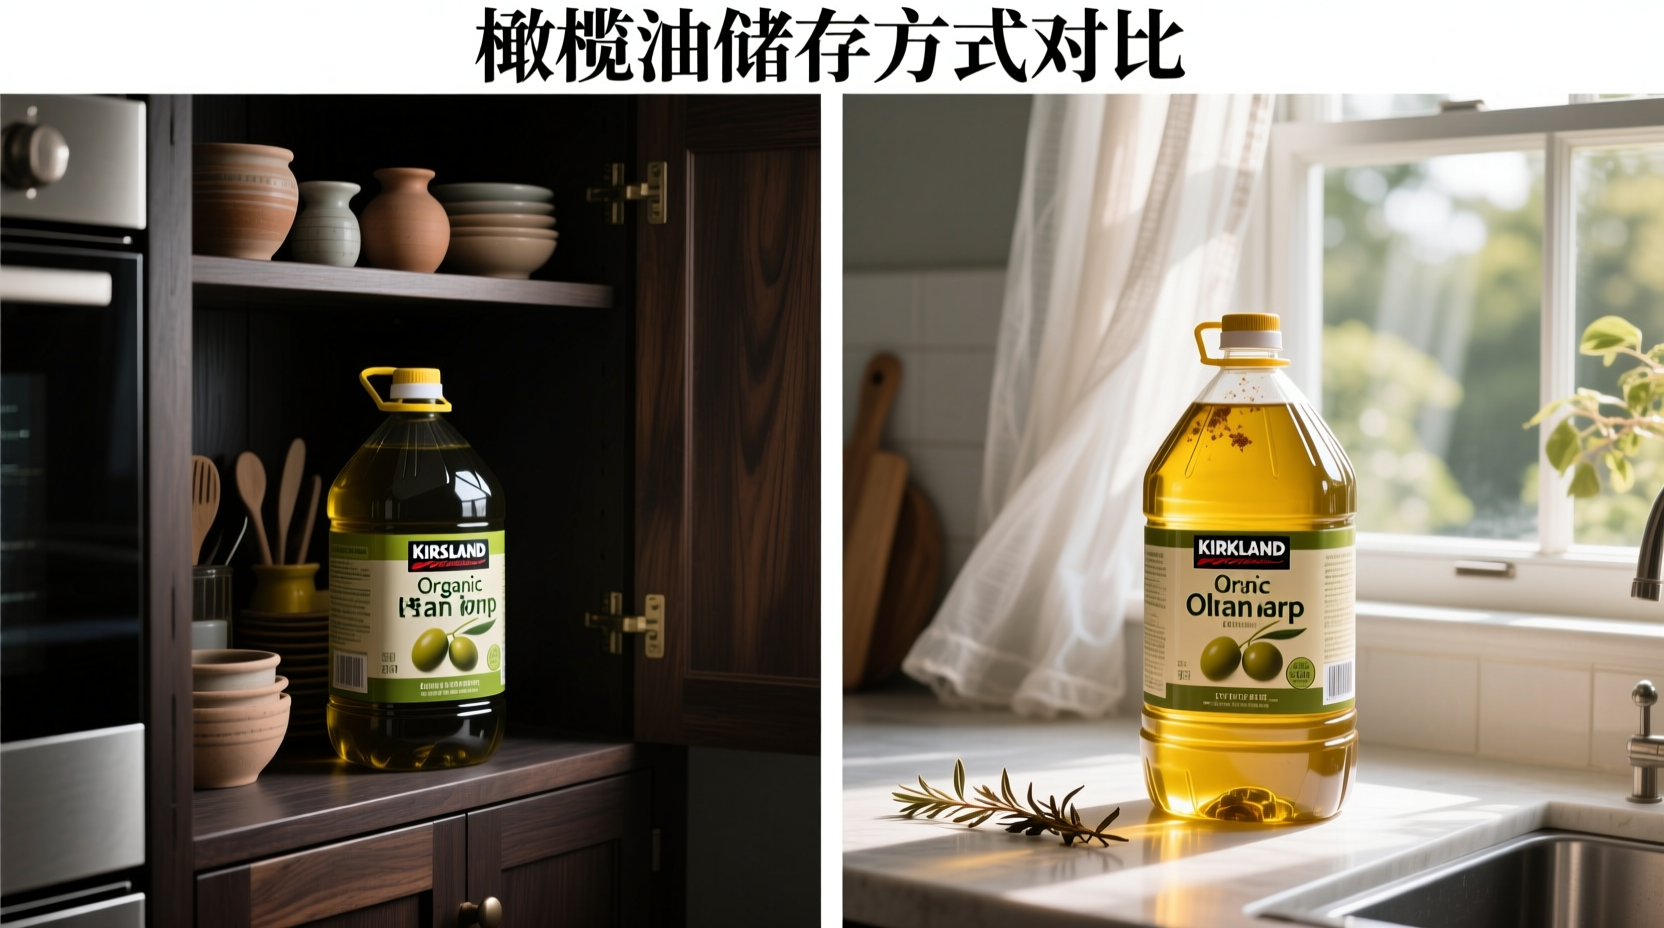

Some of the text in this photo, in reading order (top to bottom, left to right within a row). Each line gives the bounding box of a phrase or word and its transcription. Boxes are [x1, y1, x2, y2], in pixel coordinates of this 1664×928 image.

[412, 542, 486, 560] KIRSLAND
[1198, 539, 1286, 557] KIRKLAND
[417, 575, 483, 599] Organic
